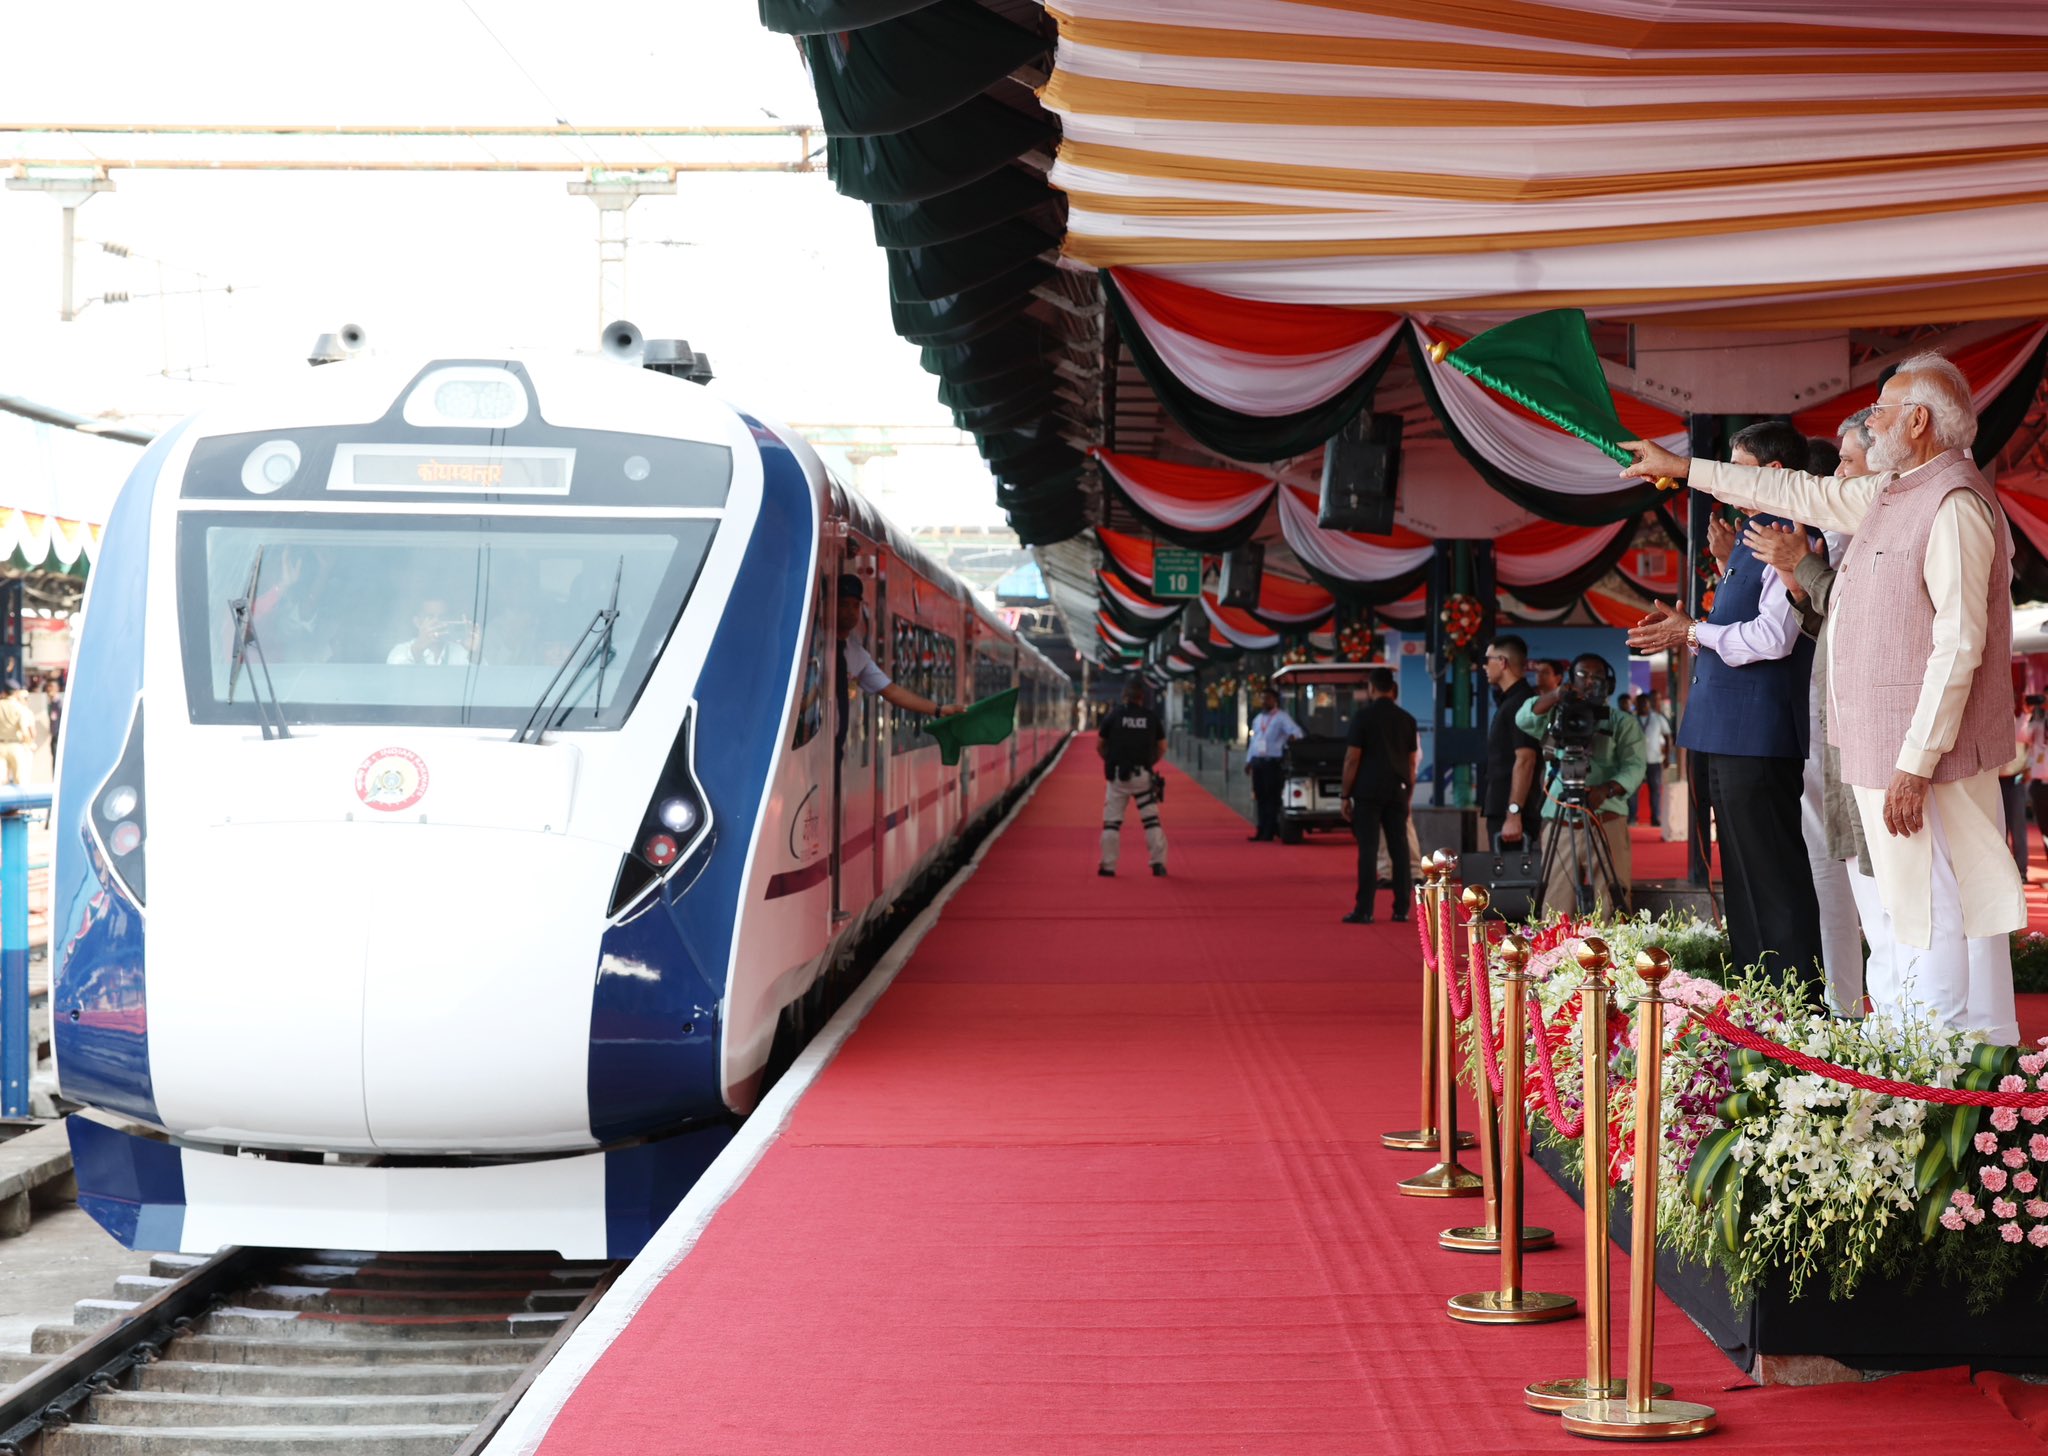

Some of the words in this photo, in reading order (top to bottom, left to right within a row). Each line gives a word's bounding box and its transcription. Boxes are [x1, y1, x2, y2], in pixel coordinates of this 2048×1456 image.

[1168, 573, 1188, 592] 10
[1122, 716, 1147, 729] POLICE
[380, 747, 416, 760] INDIAN
